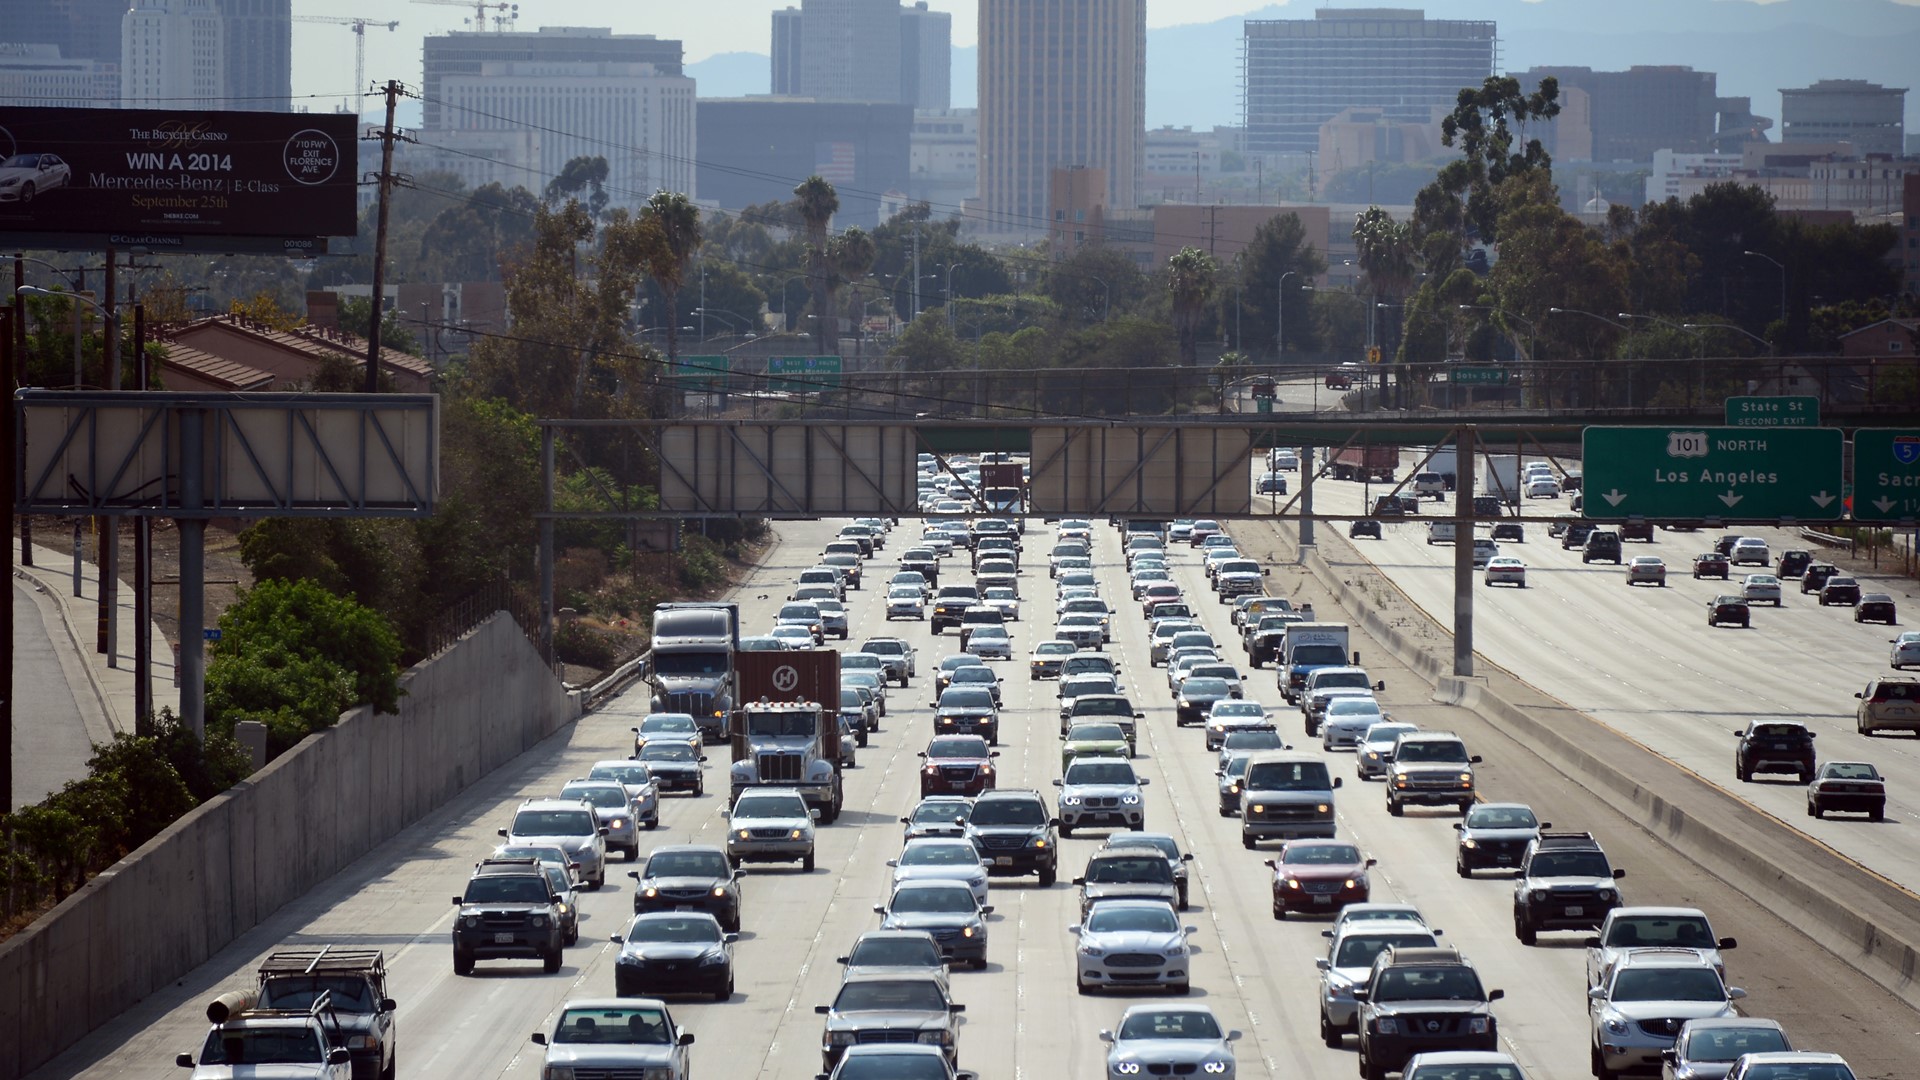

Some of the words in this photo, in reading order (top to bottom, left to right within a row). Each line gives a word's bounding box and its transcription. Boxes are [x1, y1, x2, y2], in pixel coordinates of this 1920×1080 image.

[129, 129, 150, 139] THE
[152, 130, 190, 141] BICYCLE
[191, 130, 228, 141] CASINO
[126, 152, 164, 170] WIN
[168, 154, 184, 170] A
[187, 154, 232, 171] 2014
[290, 157, 332, 166] FLORENCE
[89, 172, 223, 191] Mercedes-Benz
[234, 180, 280, 192] E-Class
[131, 194, 198, 210] September
[201, 196, 228, 208] 25th
[1741, 401, 1779, 412] State
[1788, 401, 1803, 411] St
[1738, 417, 1778, 425] SECOND
[1783, 417, 1806, 425] EXIT
[1676, 438, 1699, 451] 101
[1717, 440, 1767, 451] NORTH
[1903, 444, 1912, 458] 5
[1655, 468, 1689, 482] Los
[1699, 468, 1778, 487] Angeles
